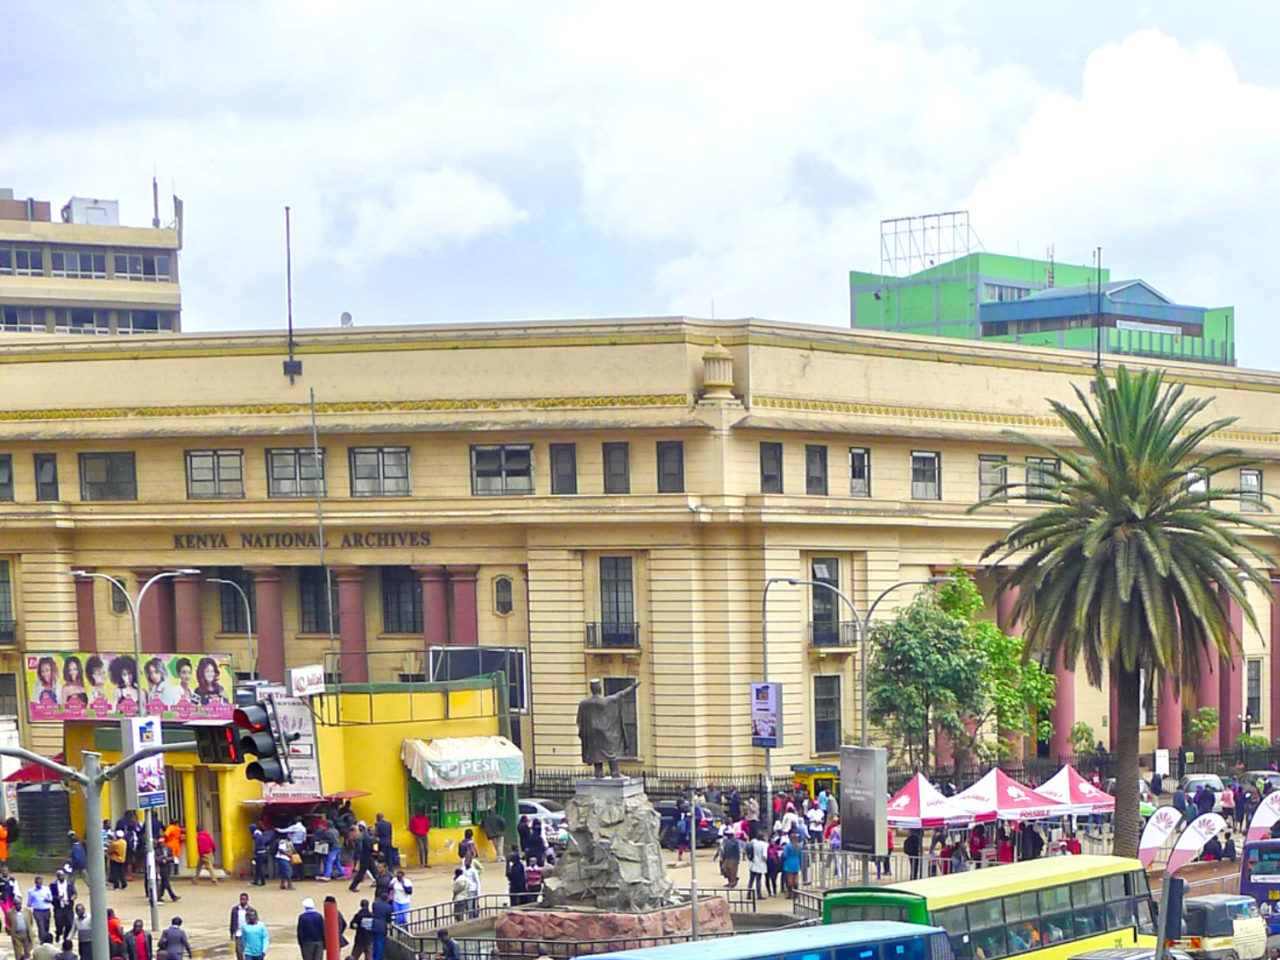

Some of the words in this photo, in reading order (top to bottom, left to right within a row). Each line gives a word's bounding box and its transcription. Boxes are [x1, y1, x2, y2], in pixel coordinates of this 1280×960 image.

[173, 533, 229, 549] KENYA
[241, 532, 329, 548] NATIONAL
[340, 531, 432, 548] ARCHIVES
